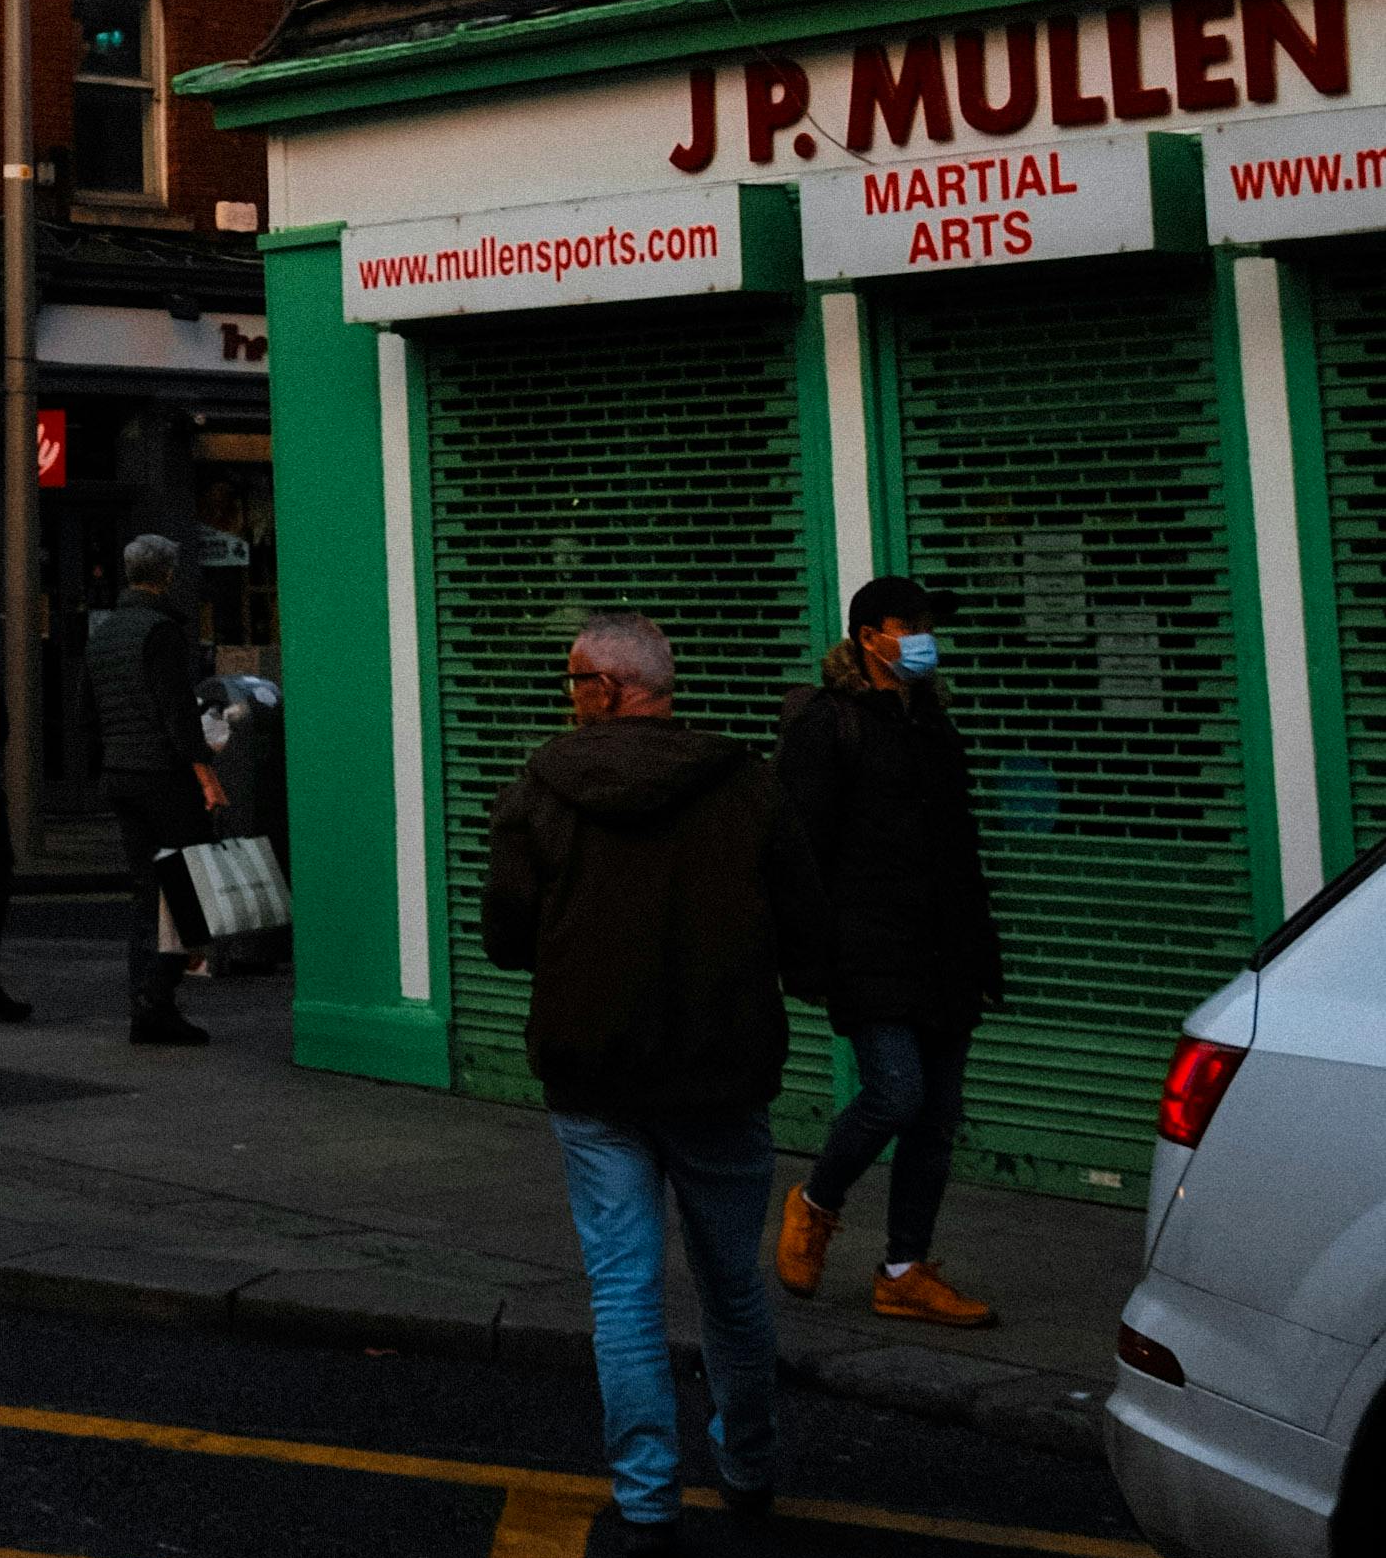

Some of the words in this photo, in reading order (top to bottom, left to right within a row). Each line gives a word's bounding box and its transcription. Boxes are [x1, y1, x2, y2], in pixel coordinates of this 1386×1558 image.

[864, 151, 1078, 217] MARTIAL
[359, 222, 717, 290] www.mullensports.com
[908, 210, 1034, 265] ARTS
